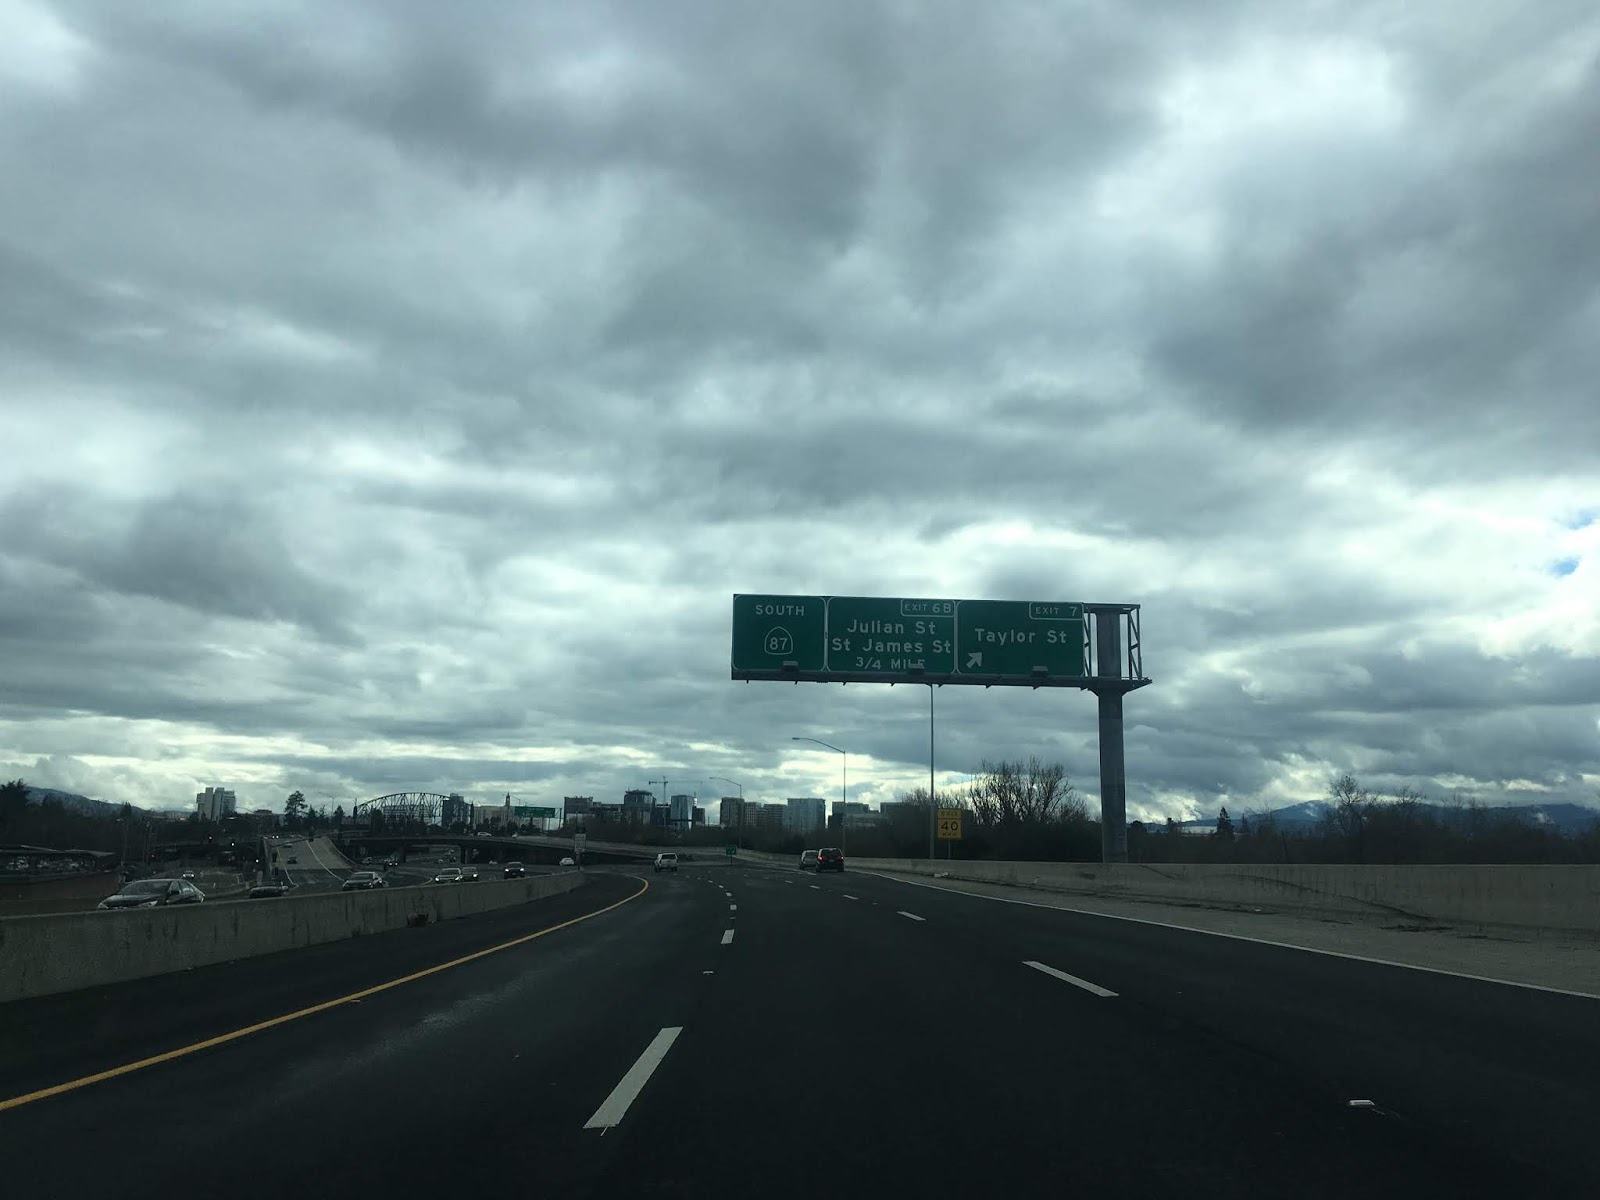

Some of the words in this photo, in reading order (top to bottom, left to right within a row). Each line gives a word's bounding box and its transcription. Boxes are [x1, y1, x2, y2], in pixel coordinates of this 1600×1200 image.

[755, 604, 805, 616] SOUTH
[904, 604, 927, 612] EXIT
[1035, 607, 1059, 615] EXIT
[1069, 606, 1077, 617] 7
[847, 619, 904, 634] Julian
[915, 620, 936, 635] St
[769, 637, 788, 650] 87
[974, 628, 1036, 646] Taylor
[1046, 629, 1067, 644] St
[831, 637, 851, 652] St
[862, 639, 923, 653] James
[932, 640, 951, 653] St
[855, 656, 882, 670] 3/4
[941, 821, 959, 831] 40
